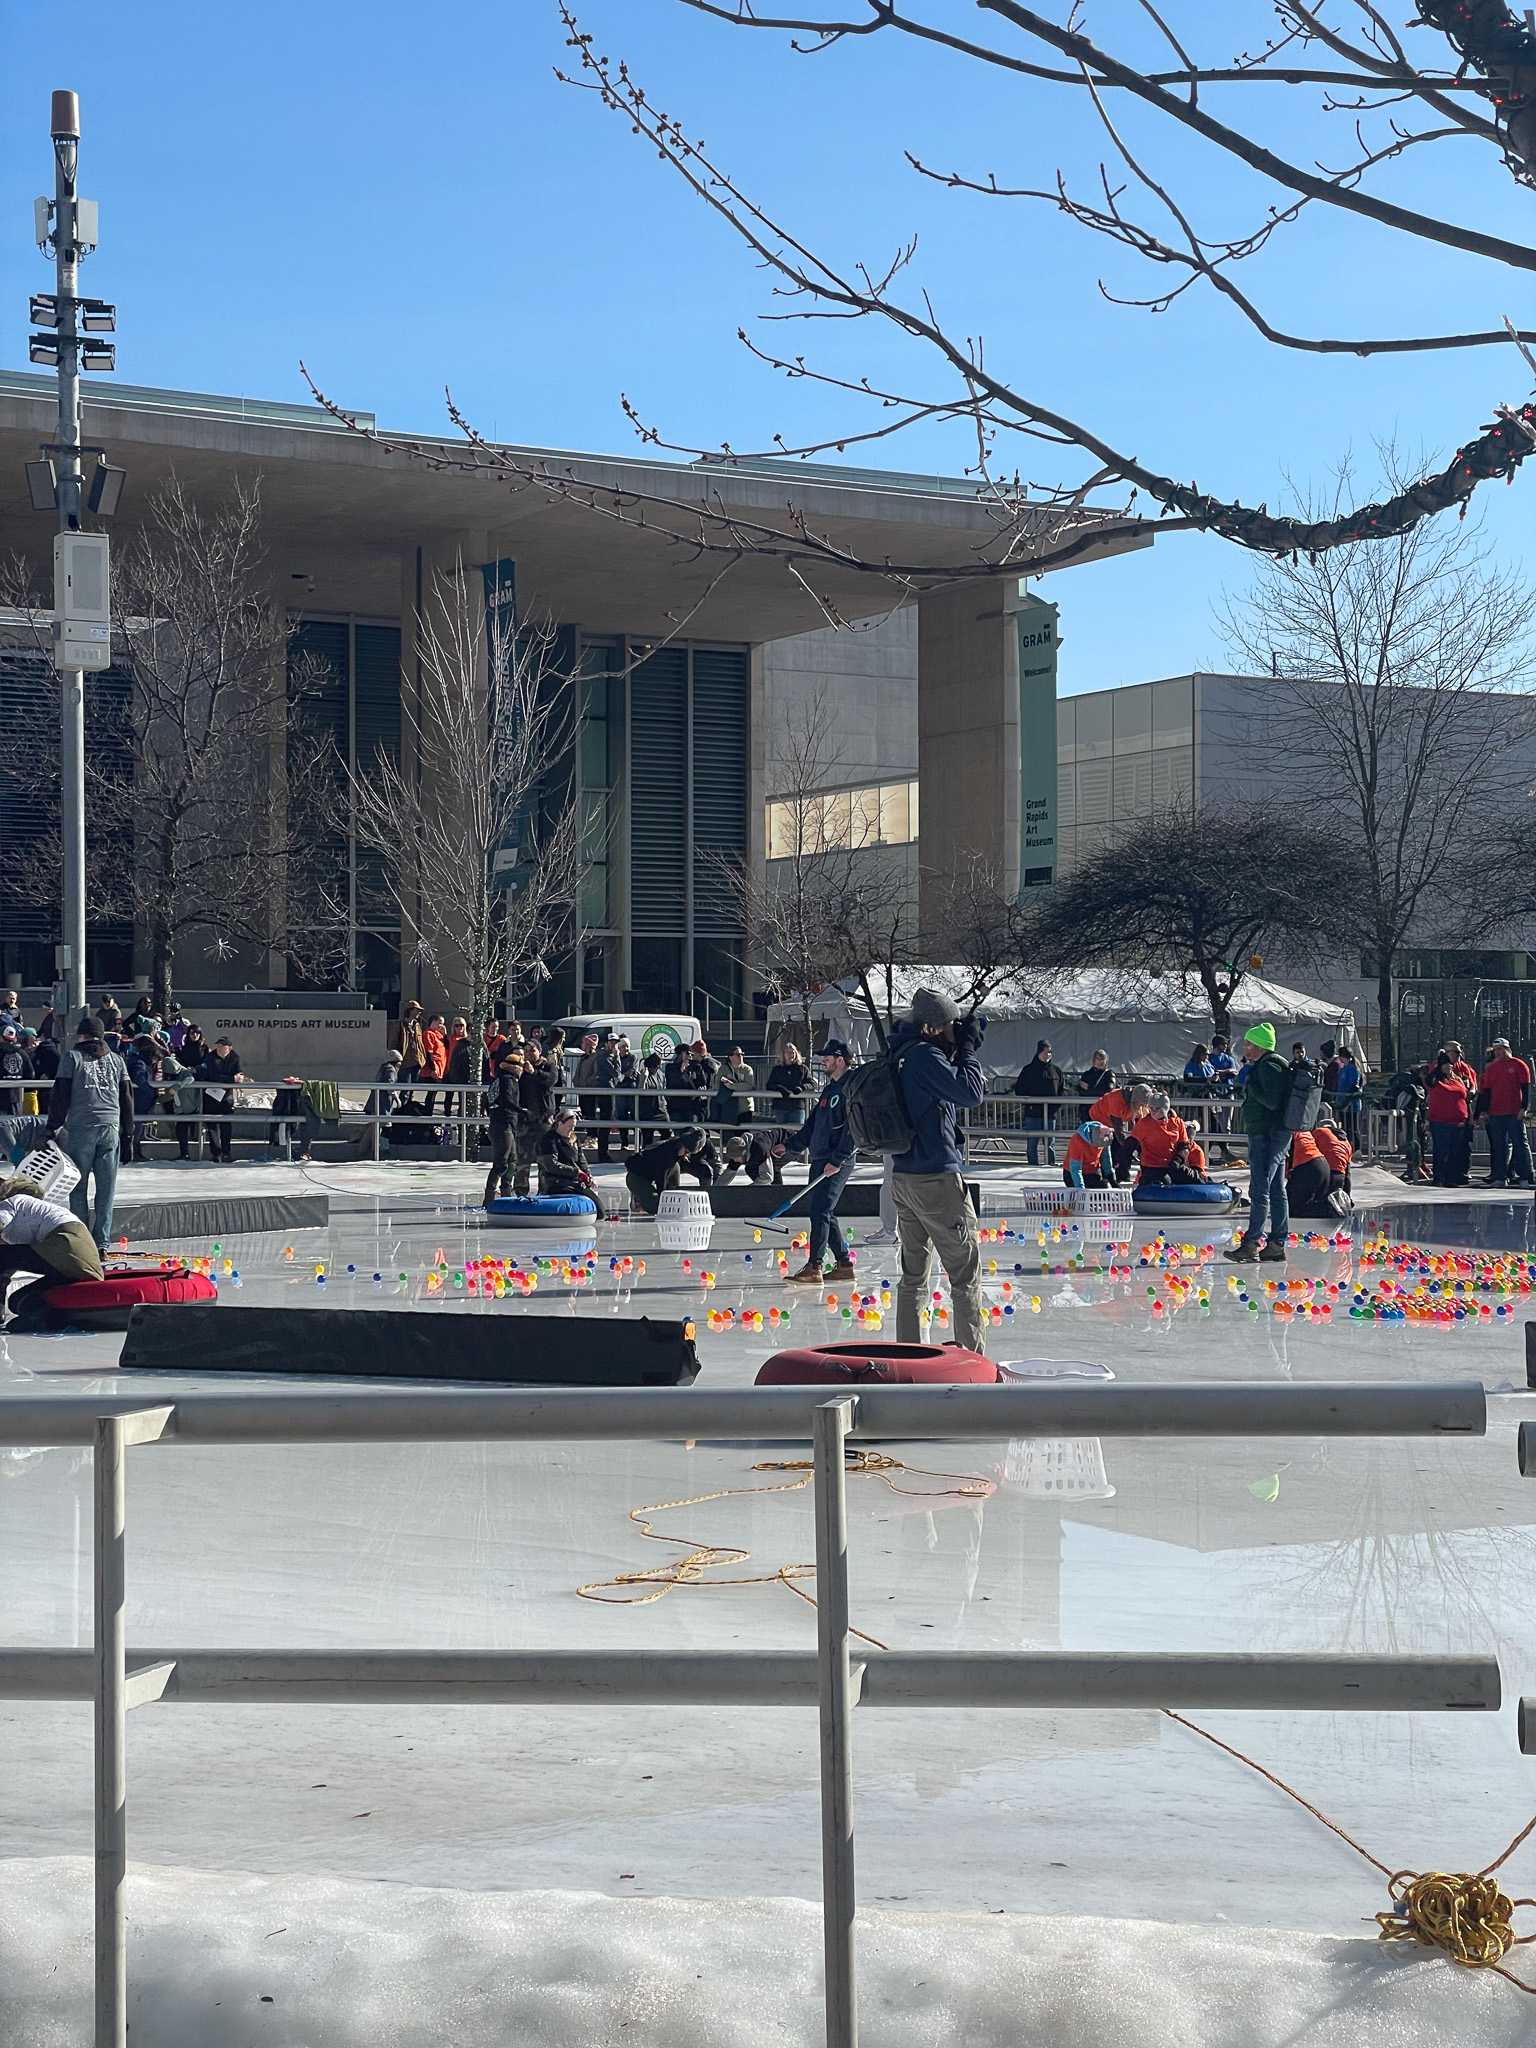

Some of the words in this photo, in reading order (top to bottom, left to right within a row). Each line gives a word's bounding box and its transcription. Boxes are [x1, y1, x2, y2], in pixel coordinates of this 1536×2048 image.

[489, 587, 513, 608] GRAM
[1023, 630, 1051, 648] GRAM
[1024, 664, 1052, 678] Welcome!
[1026, 798, 1047, 809] Grand
[1026, 811, 1049, 823] Rapids
[1026, 825, 1038, 835] Art
[1026, 837, 1054, 848] Museum
[216, 1019, 255, 1029] GRAND
[257, 1019, 298, 1029] RAPIDS
[300, 1019, 322, 1029] ART
[324, 1019, 370, 1029] MUSEUM
